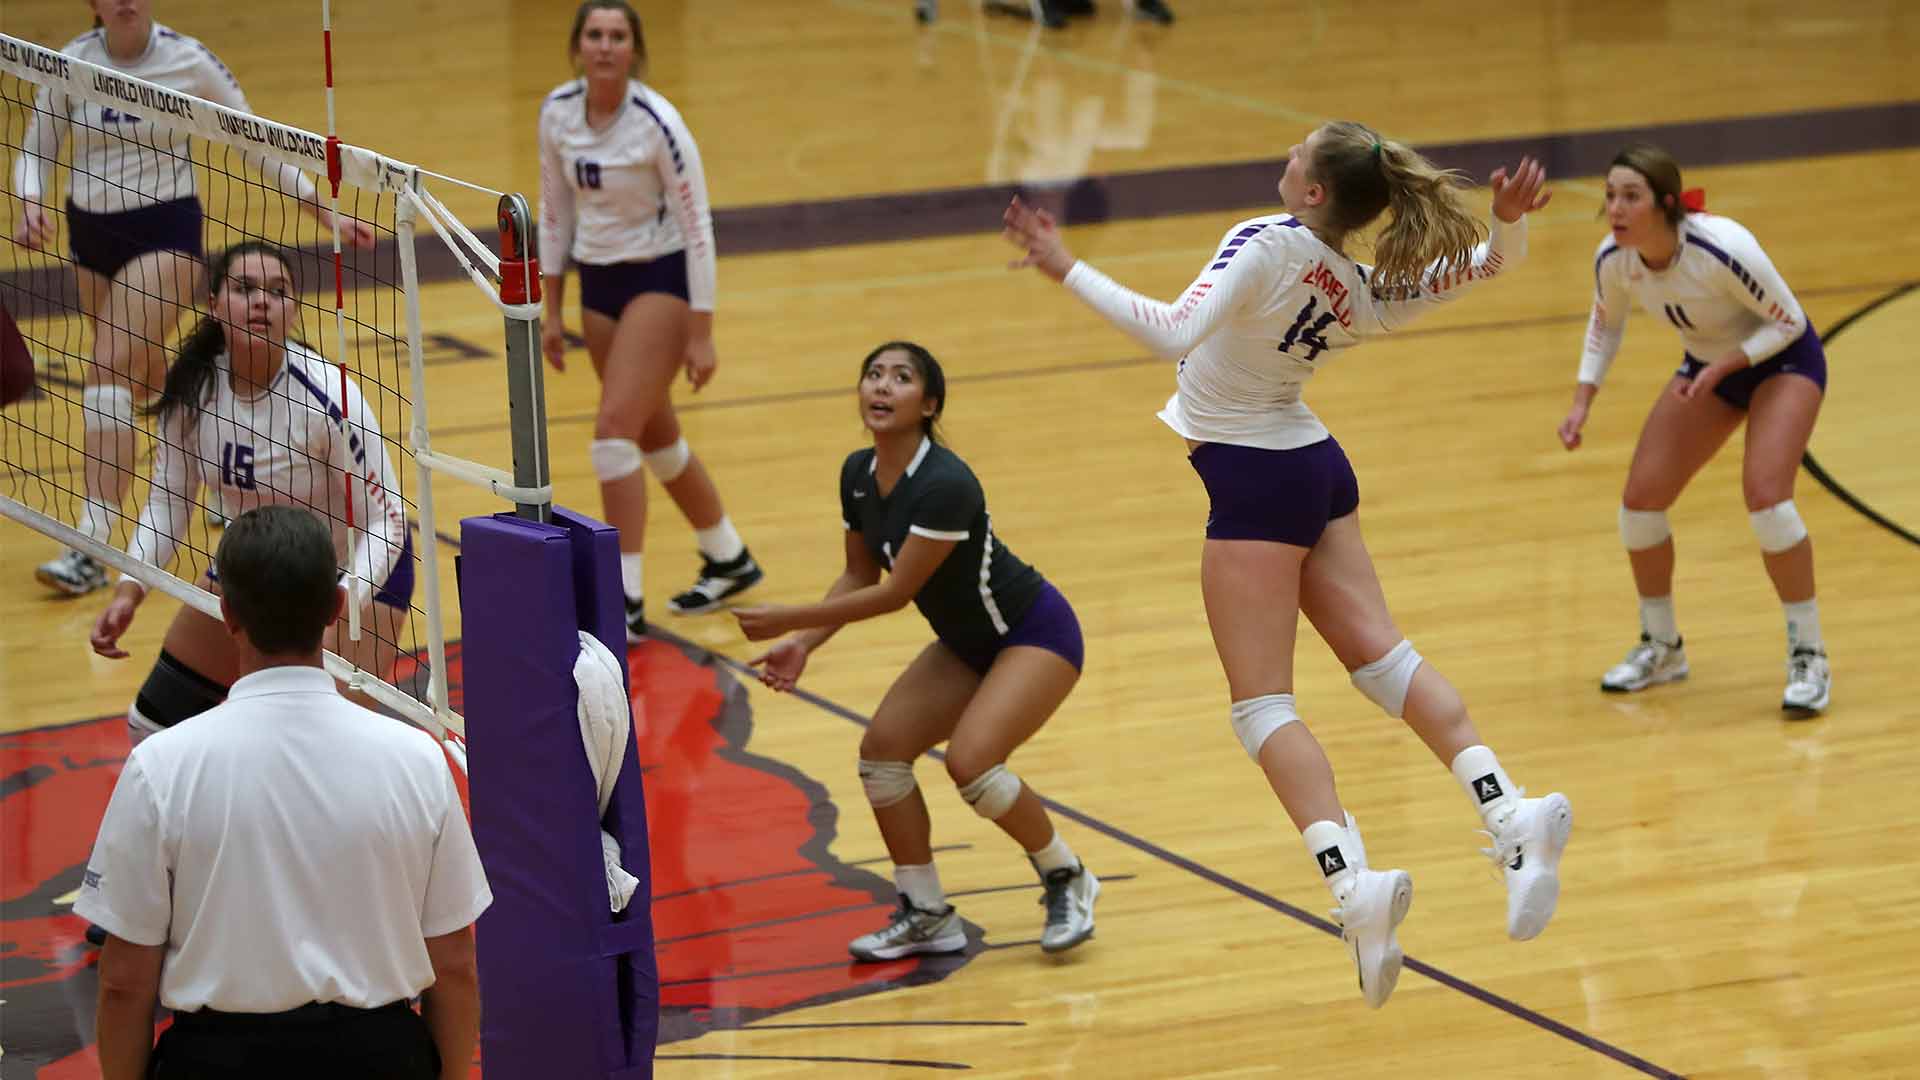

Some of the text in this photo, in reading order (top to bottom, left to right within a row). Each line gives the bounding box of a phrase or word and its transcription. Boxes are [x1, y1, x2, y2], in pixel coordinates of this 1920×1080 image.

[138, 85, 194, 120] WILDCATS
[264, 125, 326, 161] WILDCATS
[1278, 295, 1337, 361] 14
[1664, 303, 1694, 330] 11
[222, 442, 256, 490] 15
